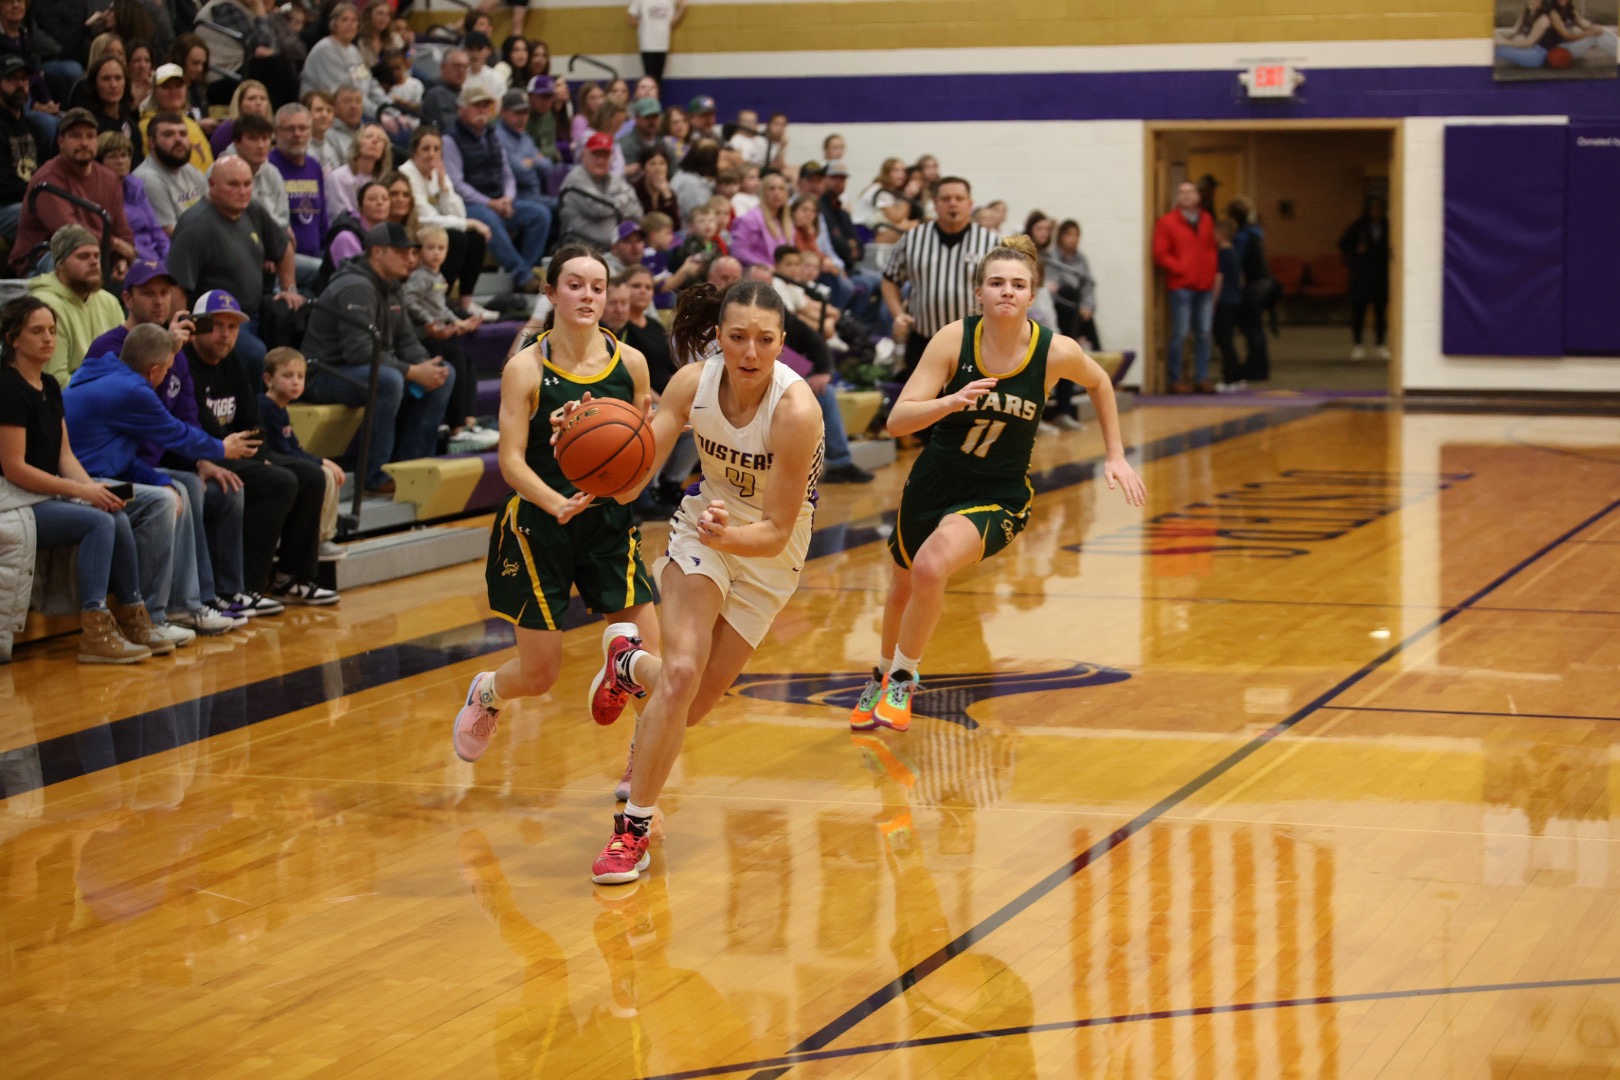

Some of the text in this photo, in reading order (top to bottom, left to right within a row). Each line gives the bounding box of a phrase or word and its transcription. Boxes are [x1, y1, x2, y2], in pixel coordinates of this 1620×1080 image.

[963, 391, 1037, 420] TARS
[960, 418, 1007, 458] 11
[725, 466, 756, 497] 4
